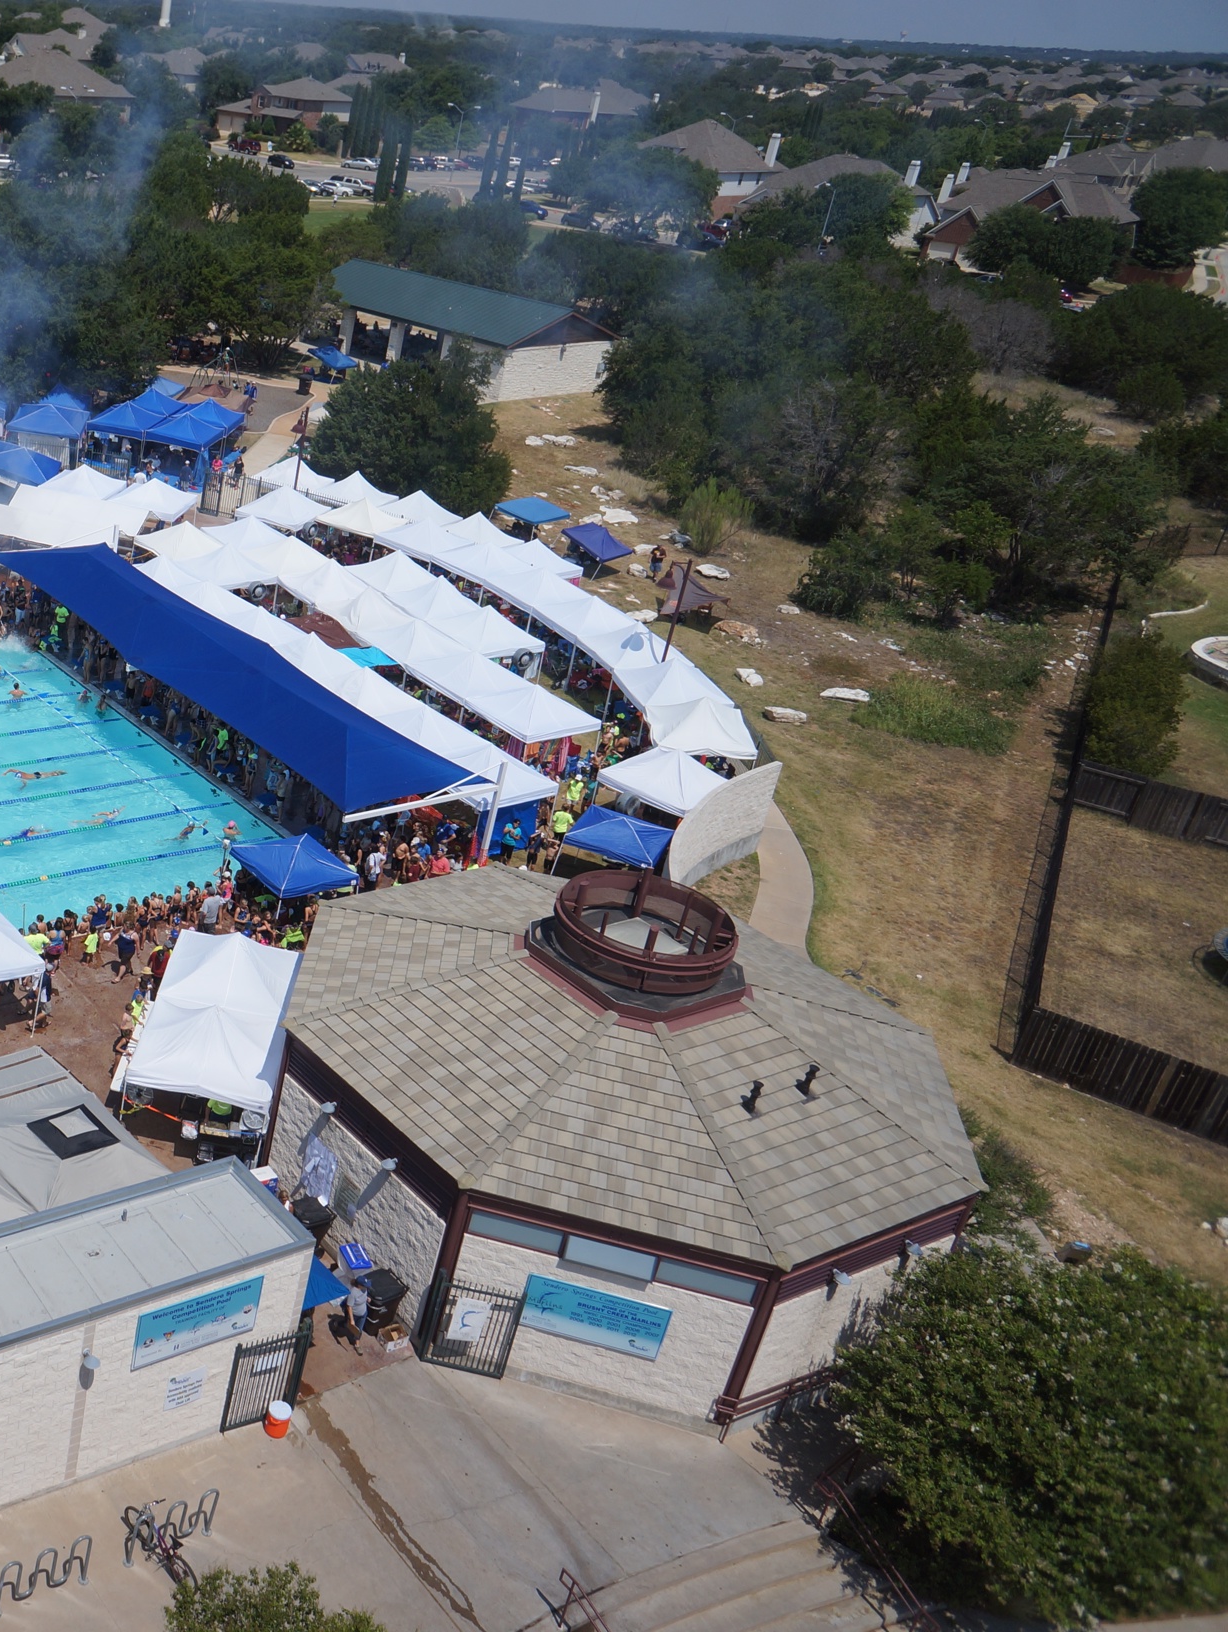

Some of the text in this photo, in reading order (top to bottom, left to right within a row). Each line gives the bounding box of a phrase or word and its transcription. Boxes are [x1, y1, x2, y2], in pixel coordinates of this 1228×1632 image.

[152, 1307, 184, 1320] Welcome
[195, 1294, 224, 1306] Sendero
[225, 1285, 251, 1297] Springs
[172, 1302, 214, 1320] Competition
[216, 1297, 231, 1305] Pool
[542, 1281, 658, 1315] Sendero Springs Competition Pool
[577, 1301, 661, 1327] BRUSHY CREEK MARLINS
